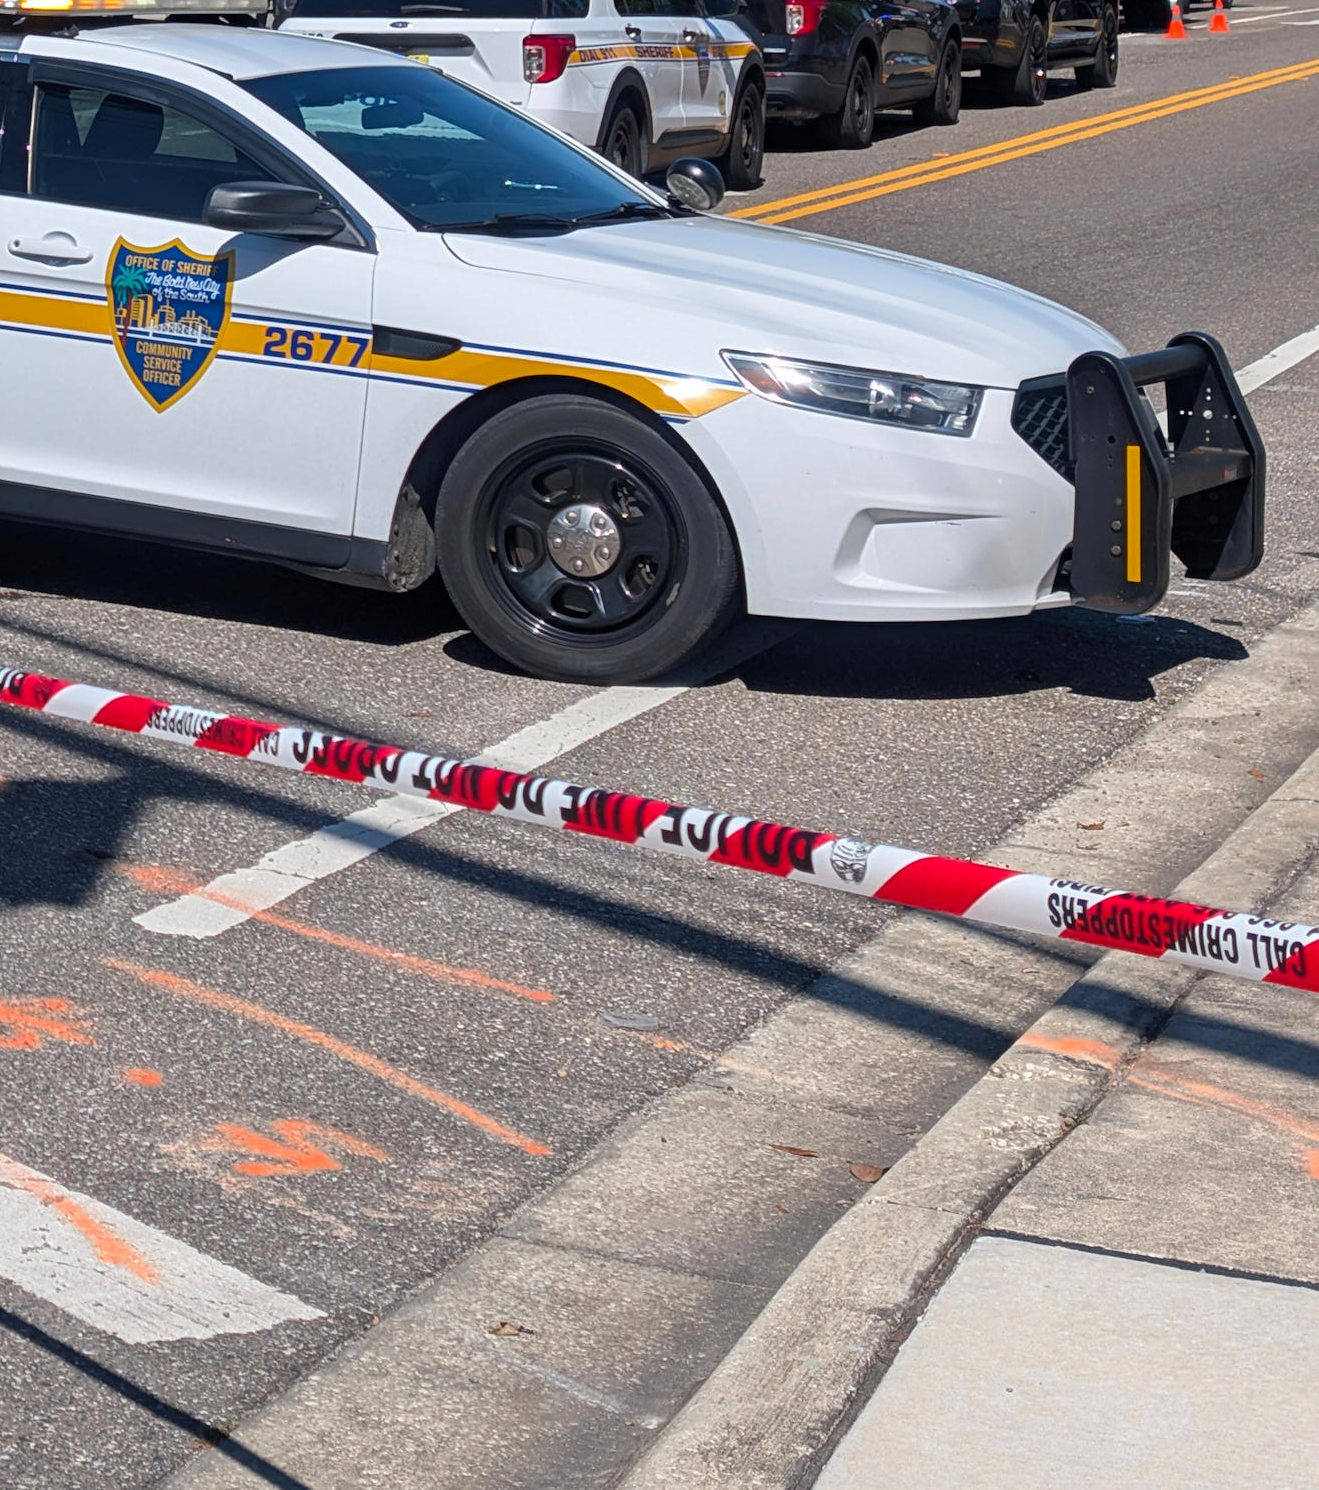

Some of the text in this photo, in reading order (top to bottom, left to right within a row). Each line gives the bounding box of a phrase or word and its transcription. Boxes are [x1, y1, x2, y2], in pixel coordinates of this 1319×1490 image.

[579, 45, 674, 62] DIAL 911 SHERIFF
[125, 254, 160, 270] OFFICE
[161, 259, 176, 272] OF
[145, 272, 163, 286] The
[162, 274, 185, 289] Bold
[152, 287, 210, 303] of the South
[136, 341, 193, 360] COMMUNITY
[264, 326, 369, 368] 2677
[143, 356, 182, 373] SERVICE
[143, 369, 181, 386] OFFICER
[1047, 891, 1240, 964] CRIMESTOPPERS
[1246, 931, 1307, 978] CALL
